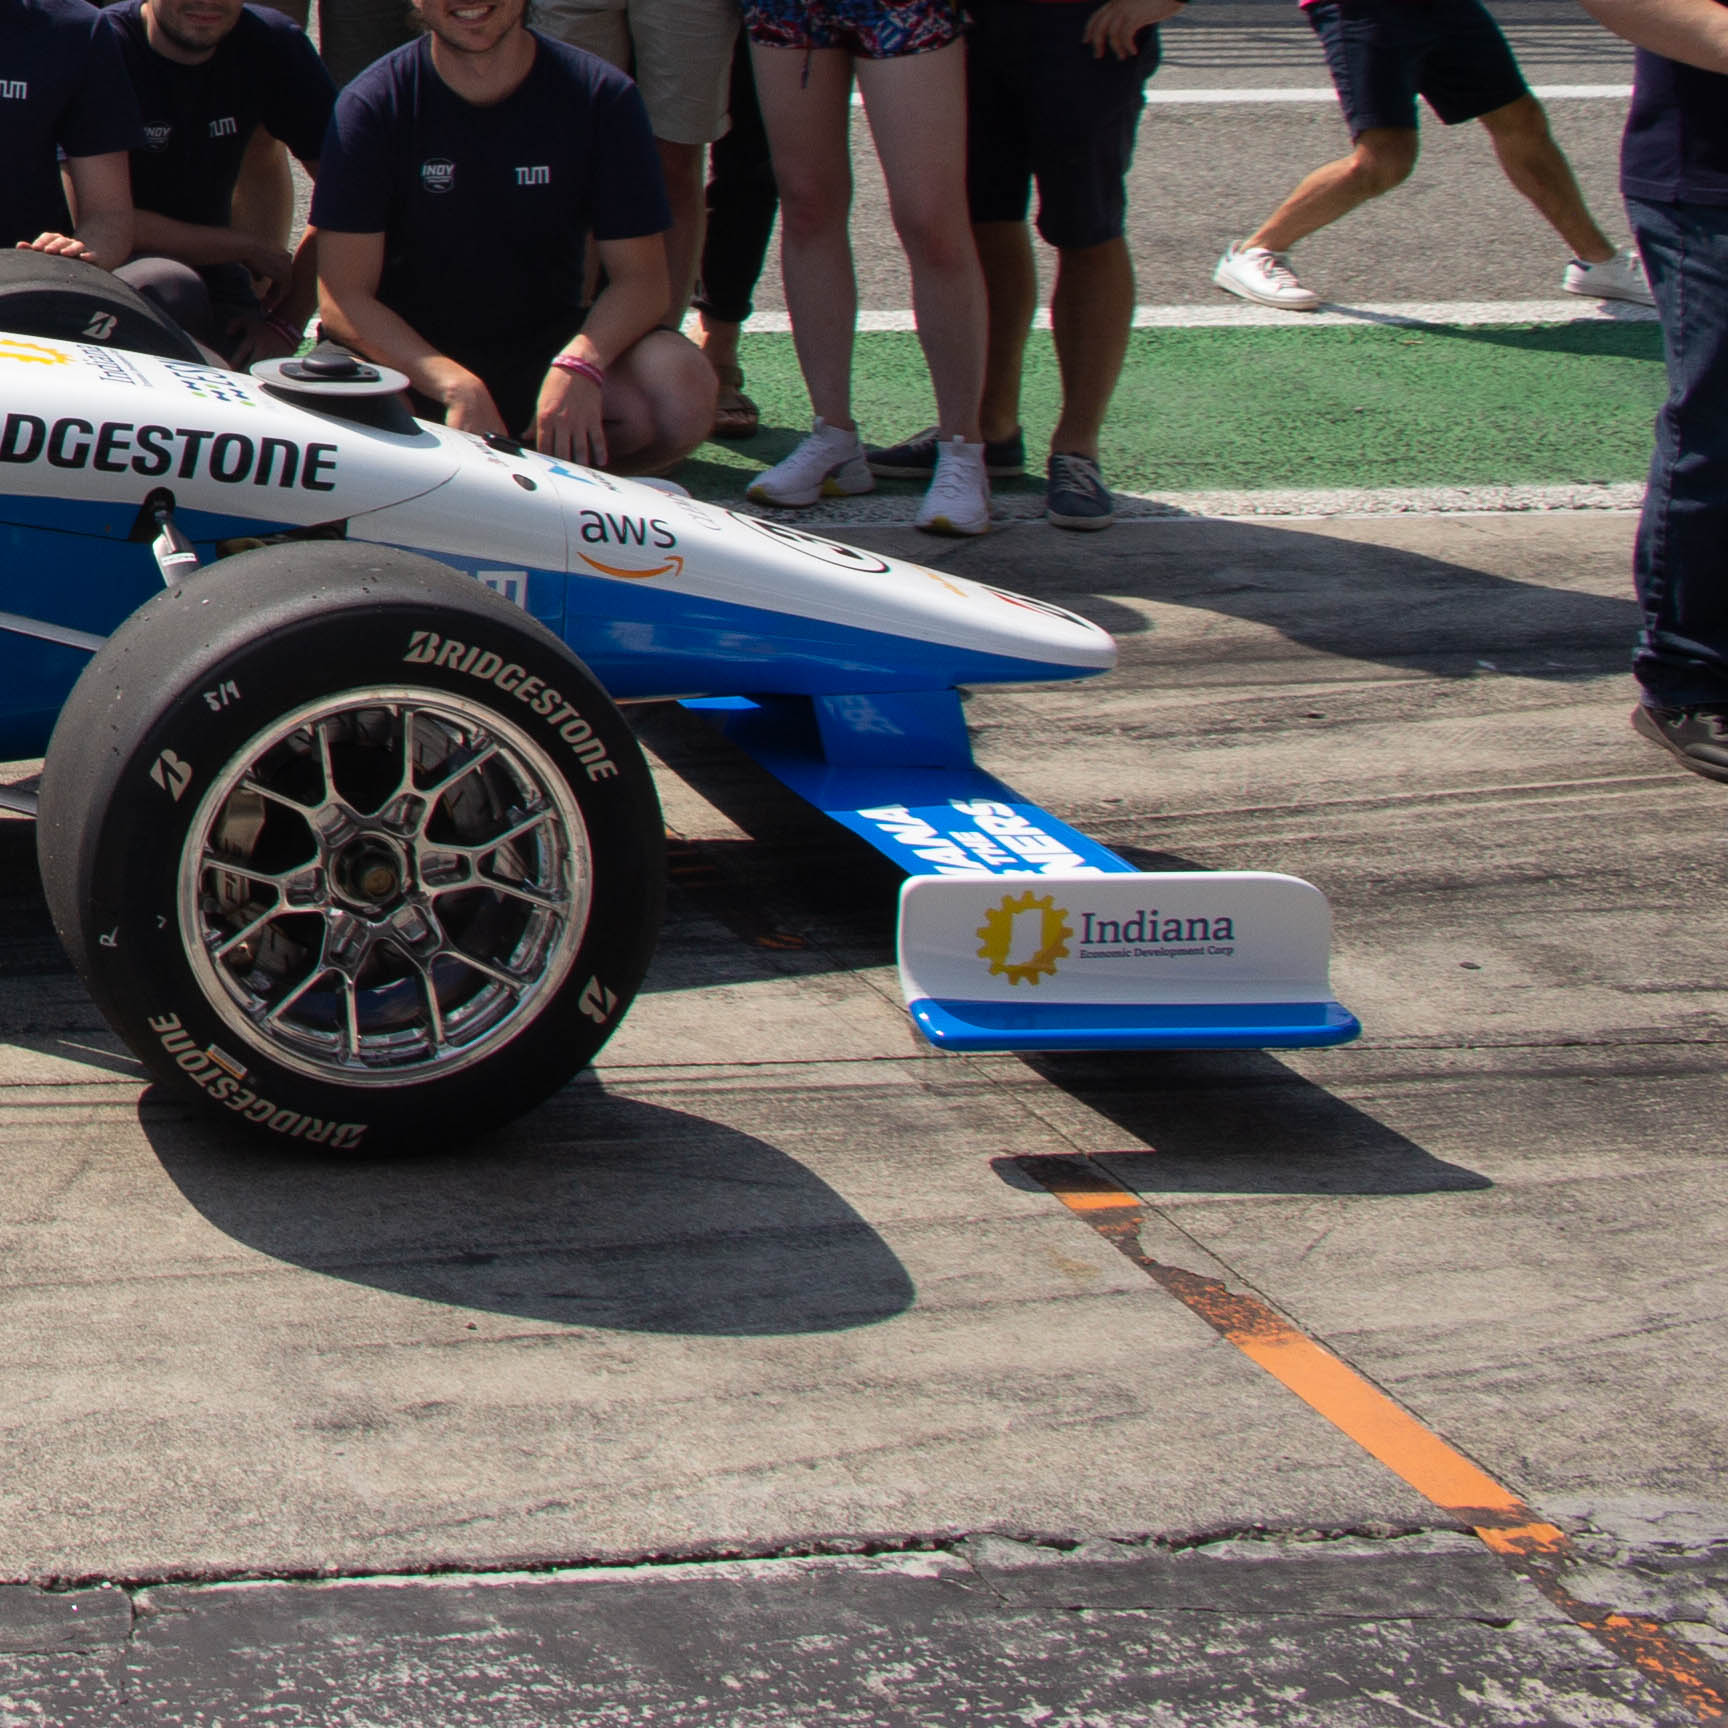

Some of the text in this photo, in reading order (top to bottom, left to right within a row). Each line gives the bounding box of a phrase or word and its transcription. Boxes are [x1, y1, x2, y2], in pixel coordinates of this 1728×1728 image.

[208, 117, 239, 138] TUM
[421, 164, 455, 178] INDY
[515, 166, 550, 185] TUM
[580, 509, 677, 549] aws
[404, 629, 619, 785] BRIDGESTONE
[1080, 909, 1234, 944] Indiana
[1080, 945, 1235, 959] Economic Development Corp
[147, 1010, 368, 1150] BRIDGESTONE
